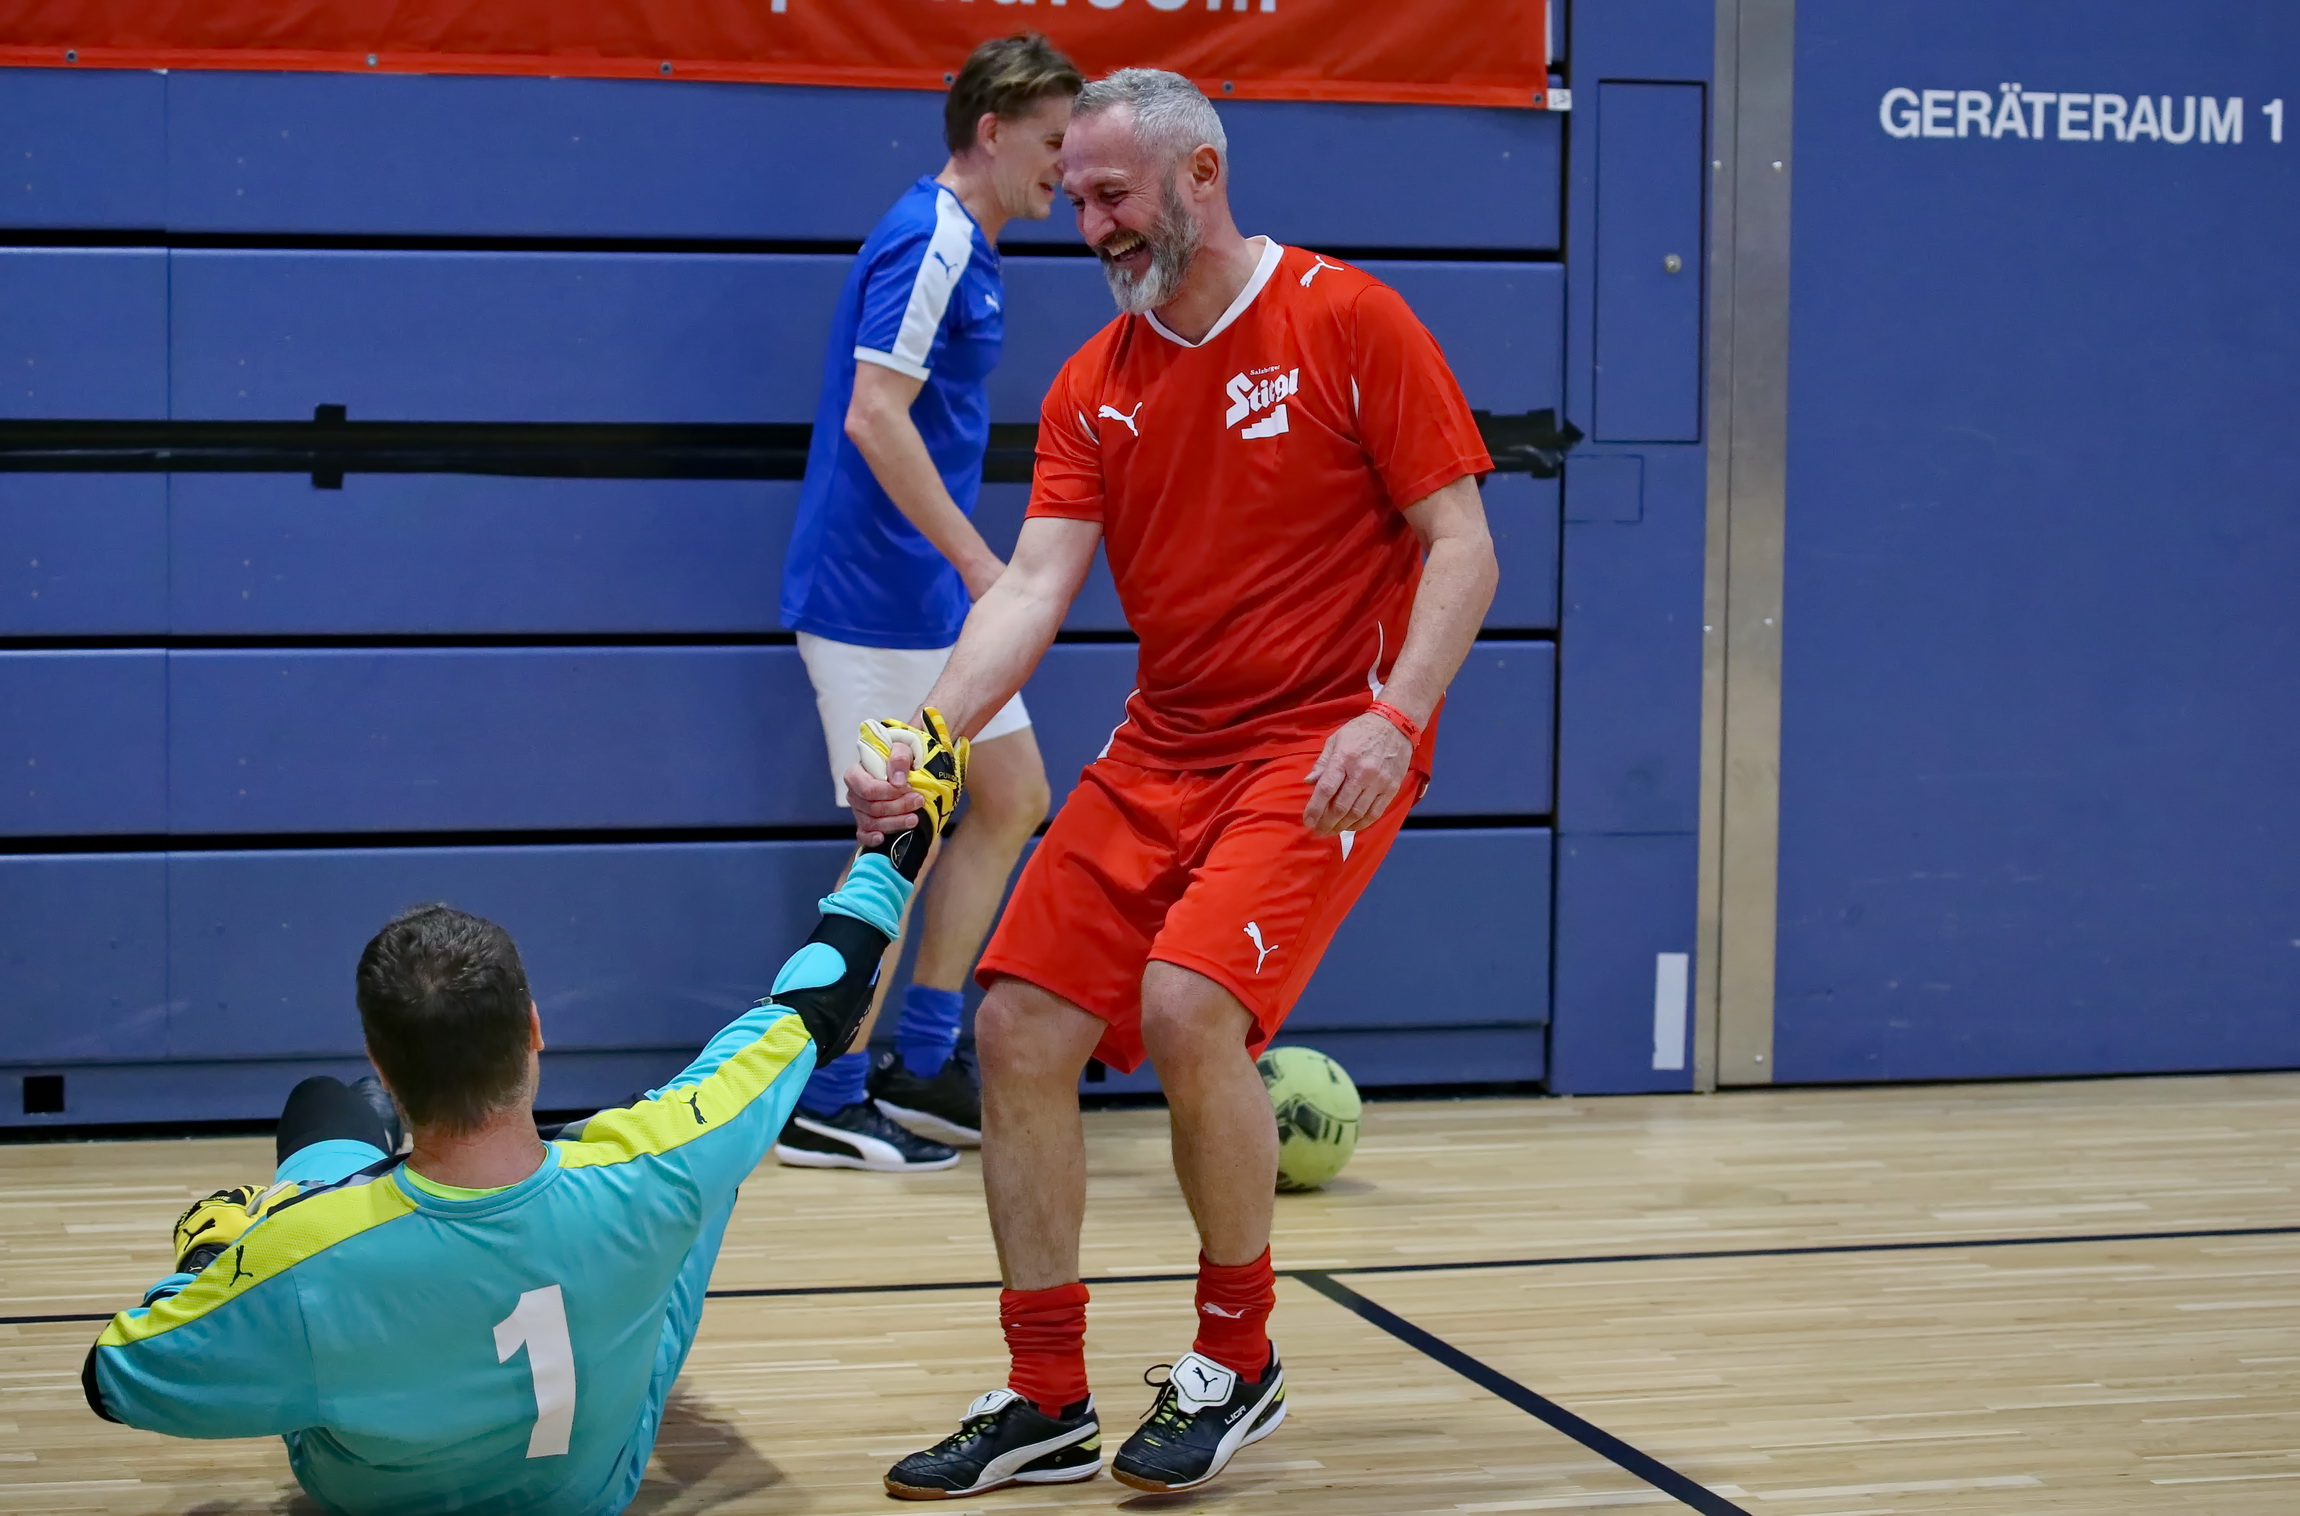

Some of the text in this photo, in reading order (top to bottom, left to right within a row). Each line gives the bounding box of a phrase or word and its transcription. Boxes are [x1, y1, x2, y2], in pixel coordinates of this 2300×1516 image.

[1880, 83, 2283, 144] GERÄTERAUM 1
[493, 1283, 576, 1459] 1
[1224, 1404, 1247, 1425] LIGA
